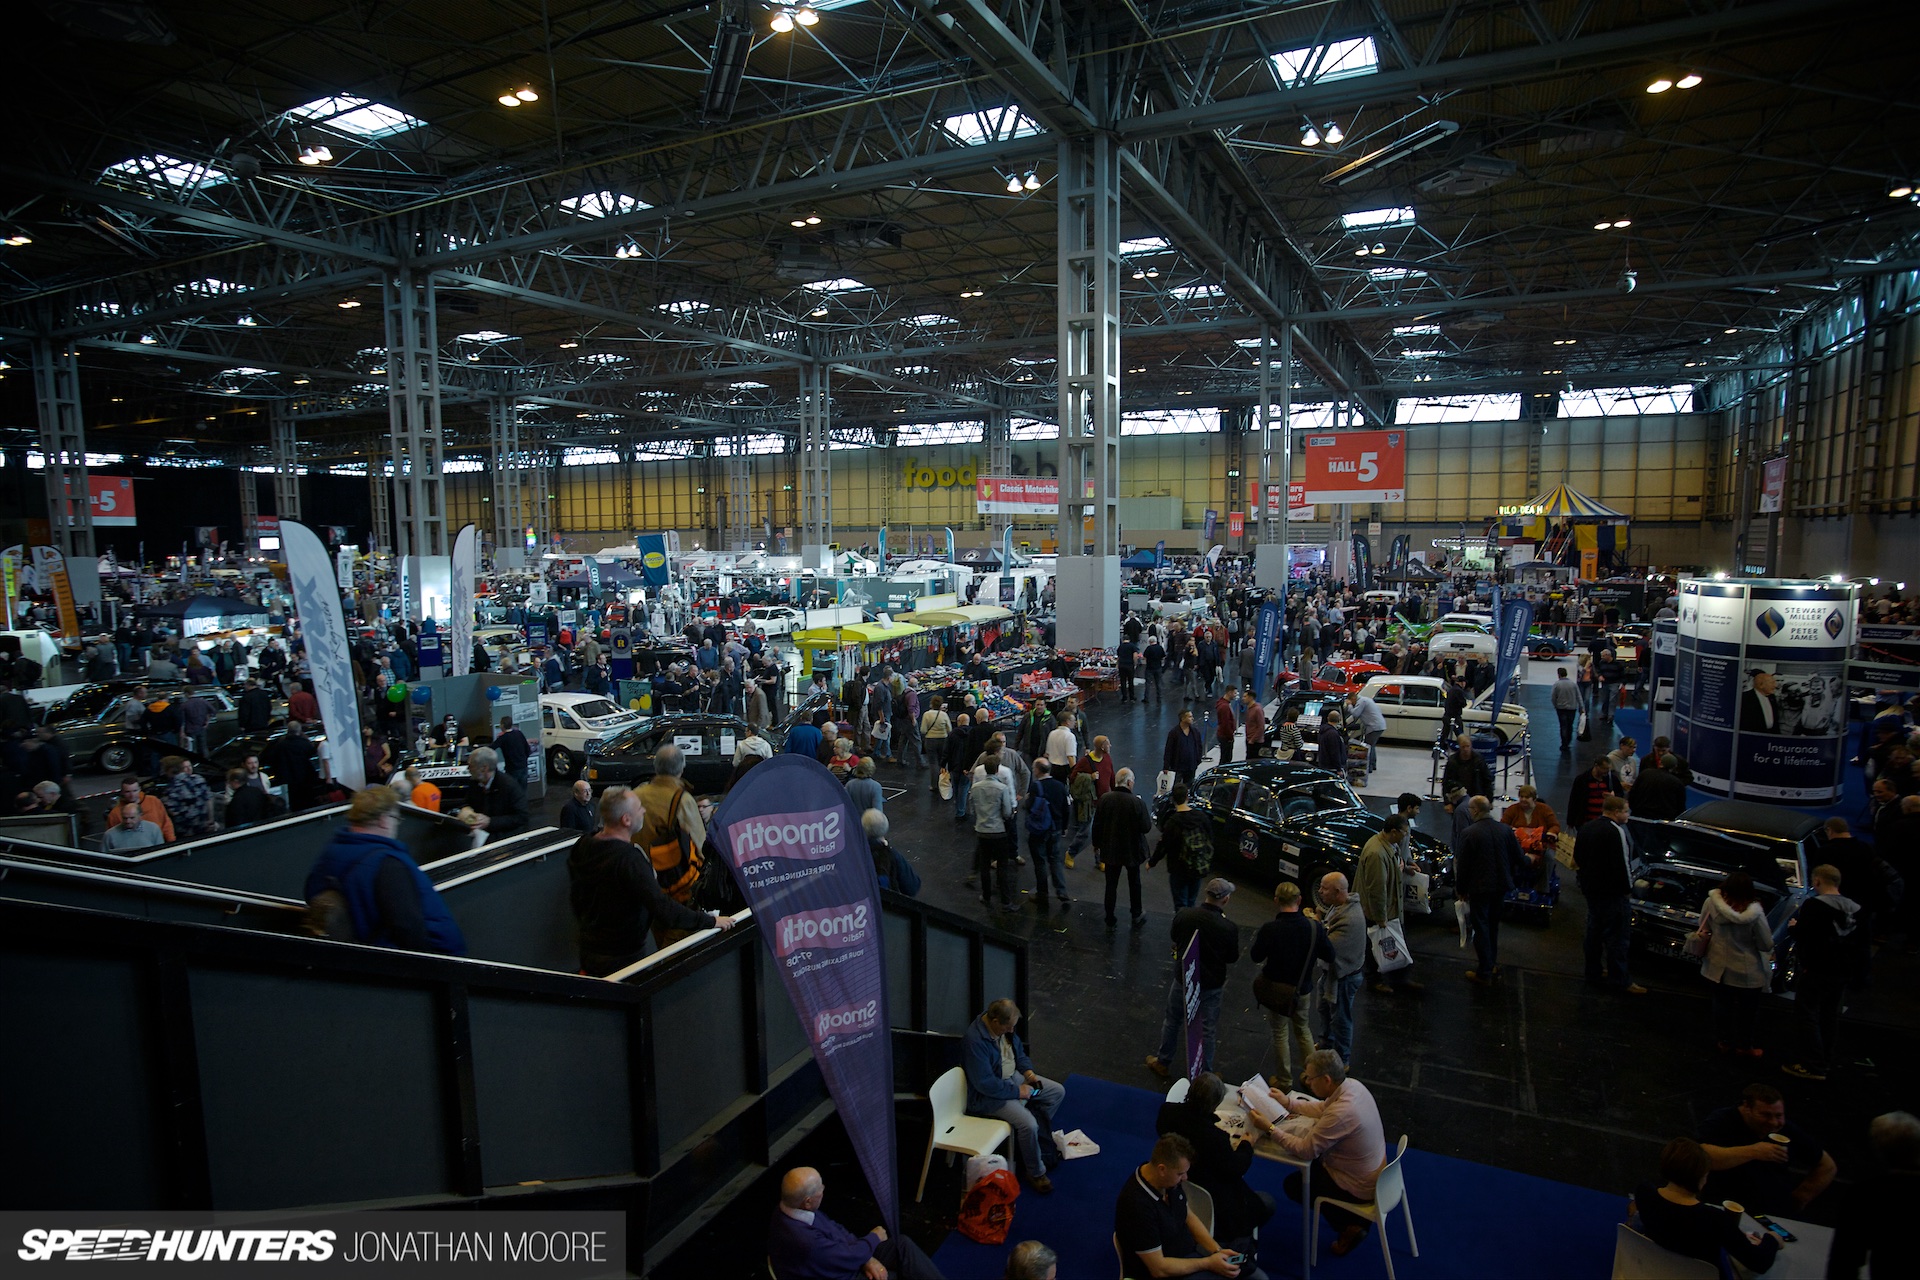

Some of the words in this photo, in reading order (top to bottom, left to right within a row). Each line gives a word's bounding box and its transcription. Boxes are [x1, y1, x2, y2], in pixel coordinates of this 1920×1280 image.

[904, 454, 977, 488] food
[1328, 461, 1356, 473] HALL
[1358, 452, 1378, 482] 5
[1000, 484, 1024, 493] Classic
[100, 490, 116, 512] 5
[1506, 632, 1517, 657] Morris
[1513, 609, 1523, 631] Leslie
[1259, 637, 1267, 664] Morris
[1753, 753, 1769, 764] for
[1773, 756, 1781, 765] a
[1768, 742, 1819, 754] Insurance
[1244, 840, 1254, 851] 27
